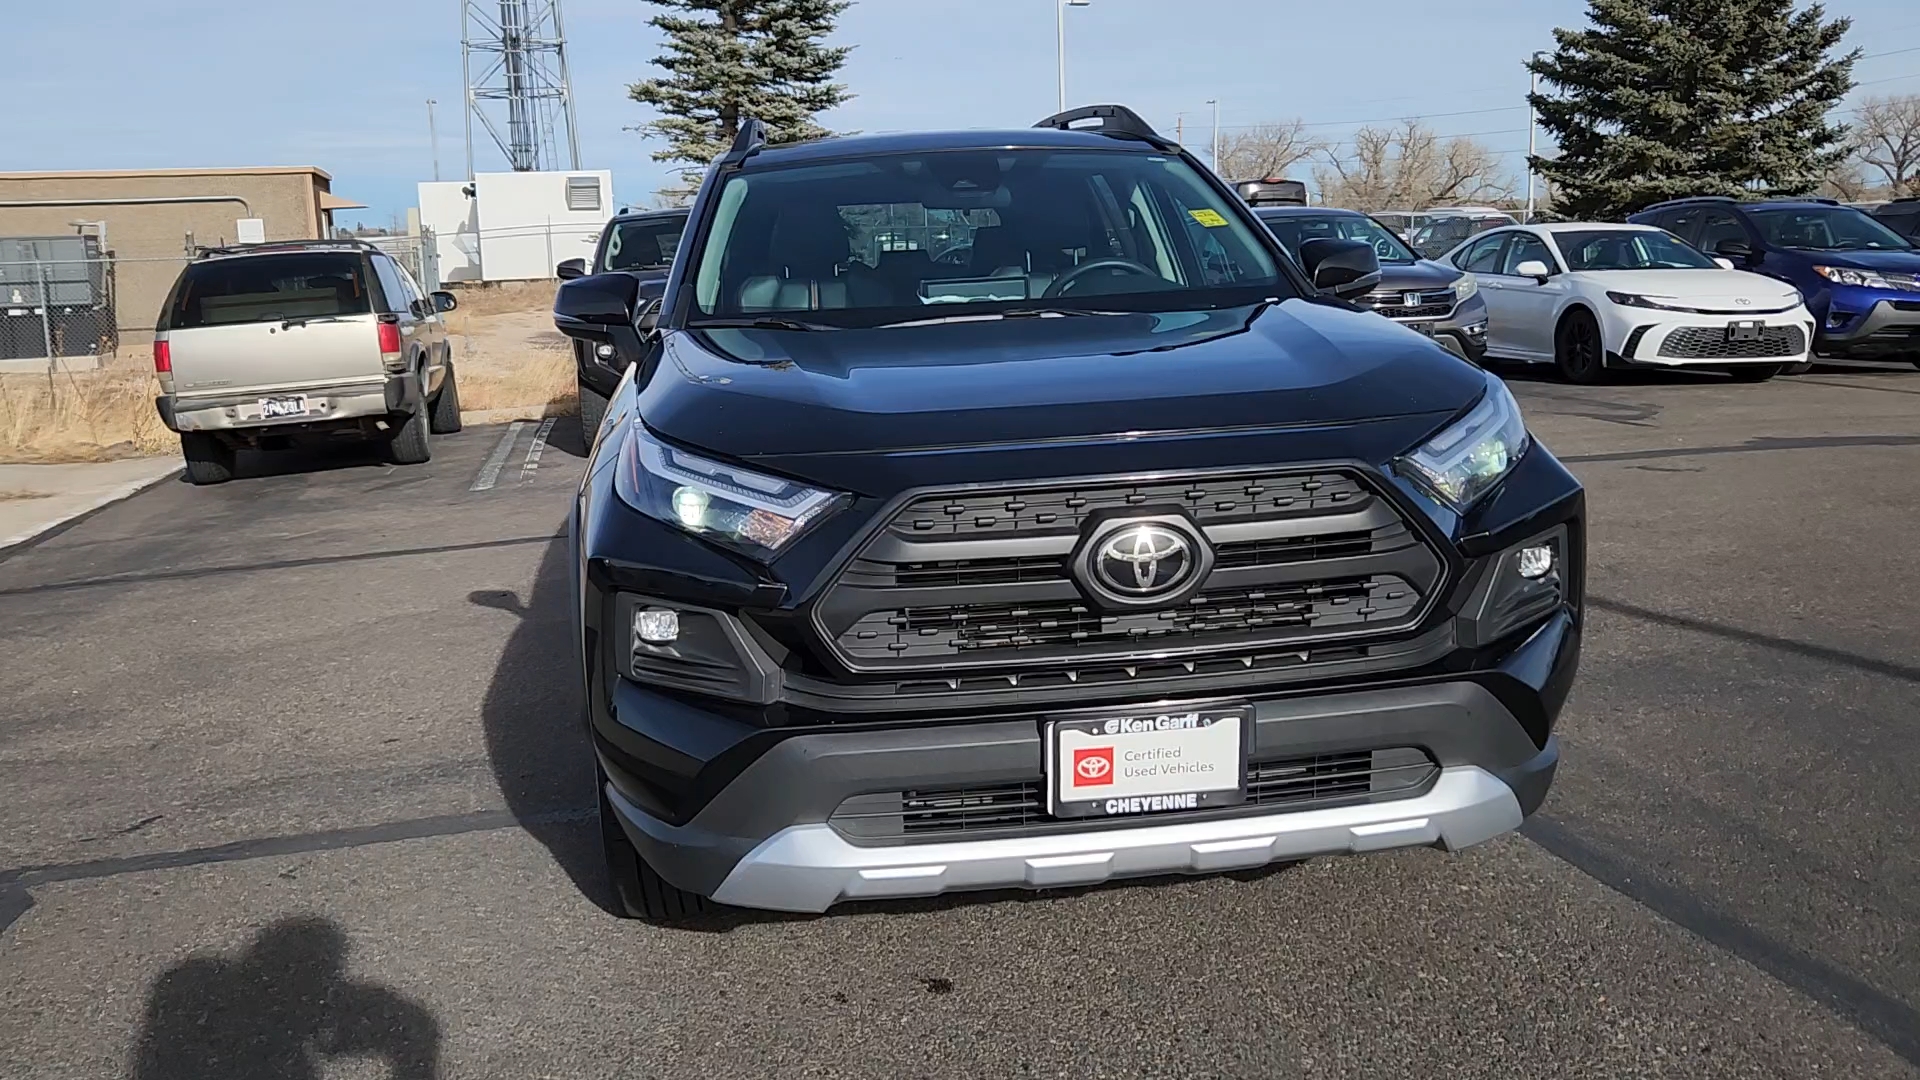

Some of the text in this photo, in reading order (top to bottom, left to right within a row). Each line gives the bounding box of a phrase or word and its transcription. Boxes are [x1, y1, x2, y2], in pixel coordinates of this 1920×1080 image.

[1120, 717, 1154, 733] Ken
[1155, 713, 1199, 730] Garff
[1124, 746, 1181, 762] Certified
[1124, 761, 1215, 778] Used Vehicles
[1105, 794, 1198, 815] CHEYENNE
